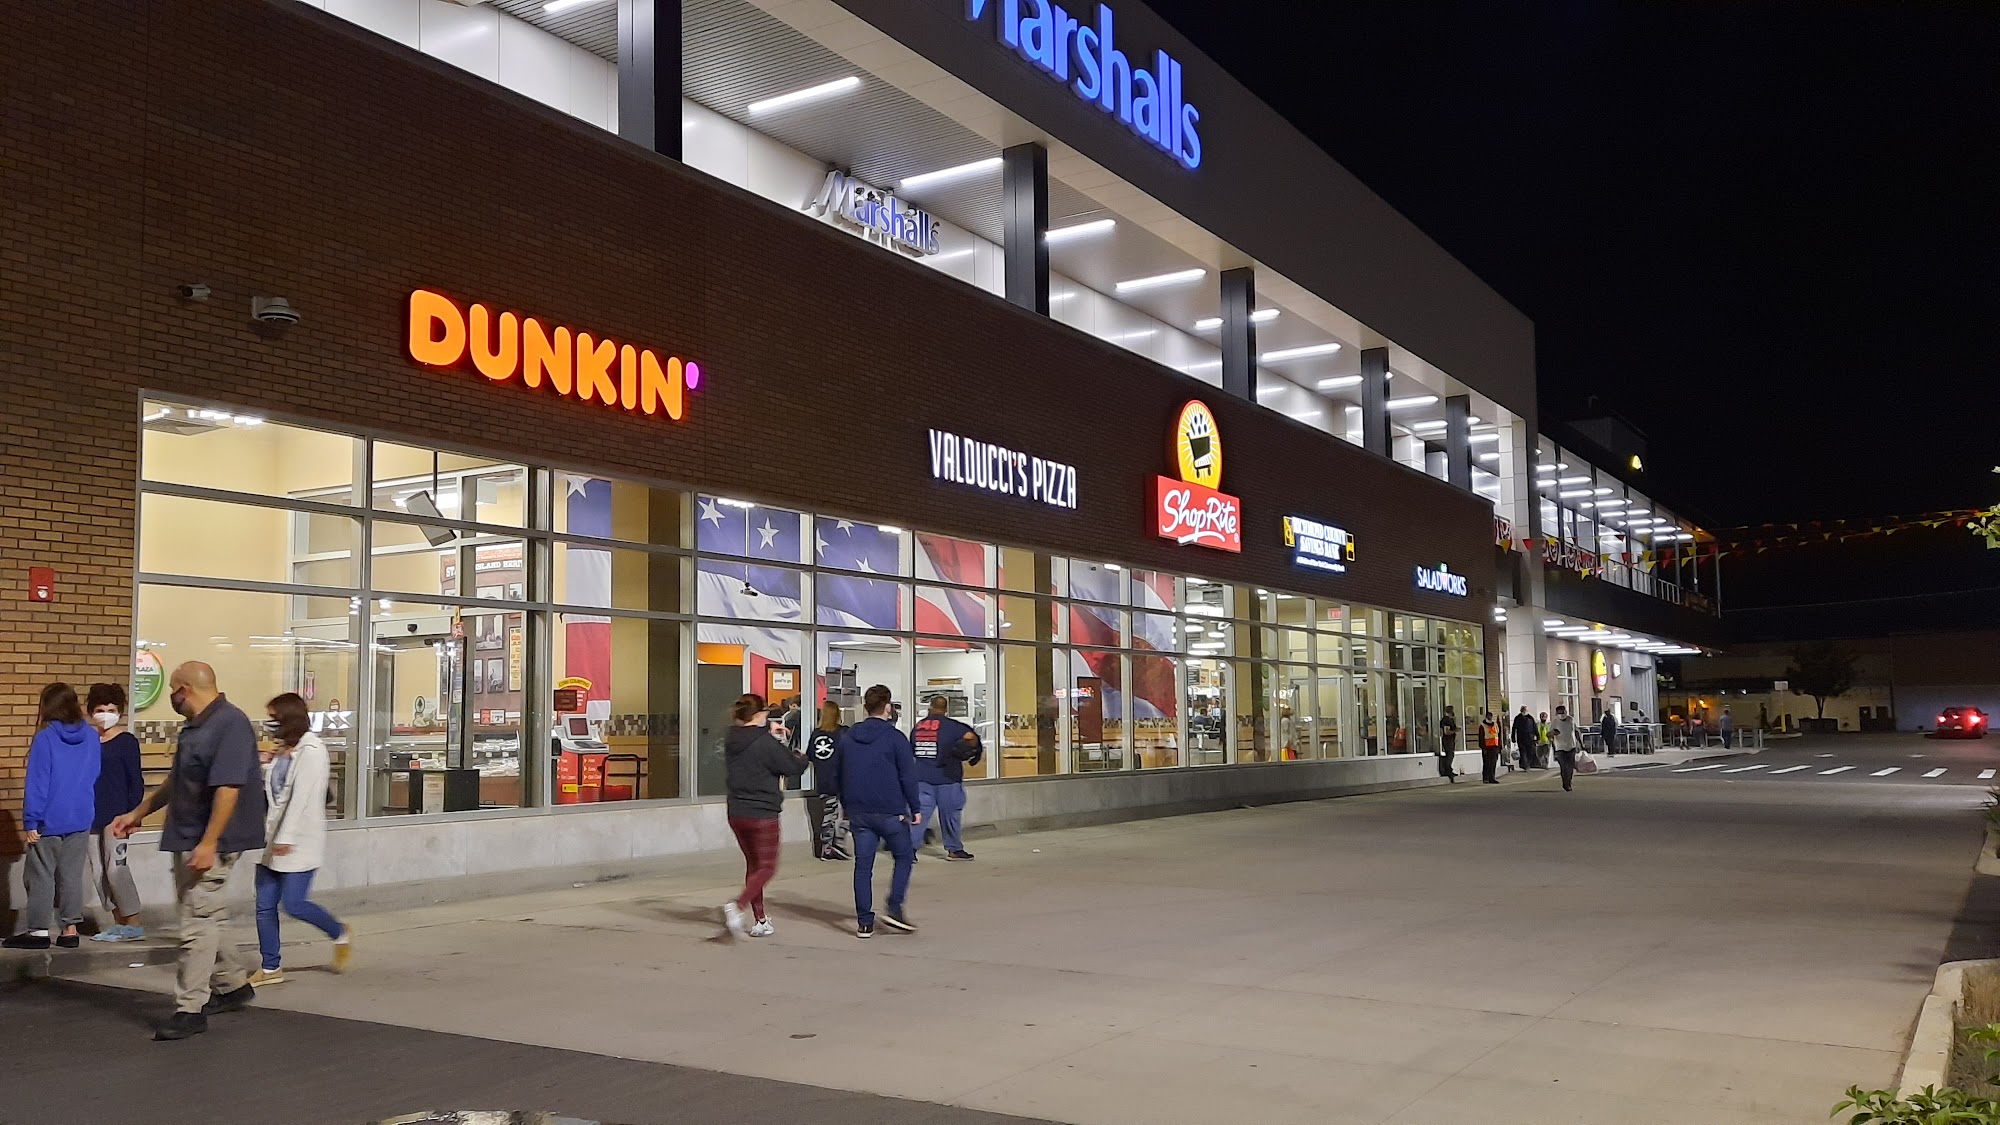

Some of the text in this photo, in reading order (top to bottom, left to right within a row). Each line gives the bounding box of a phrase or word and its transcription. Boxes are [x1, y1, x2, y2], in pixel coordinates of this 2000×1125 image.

[816, 170, 940, 255] Marshalls
[409, 289, 700, 420] DUNKIN'
[929, 428, 1077, 509] VALDUCCI'S PIZZA
[1161, 489, 1237, 543] ShopRite
[1417, 565, 1467, 596] SALADWORKS
